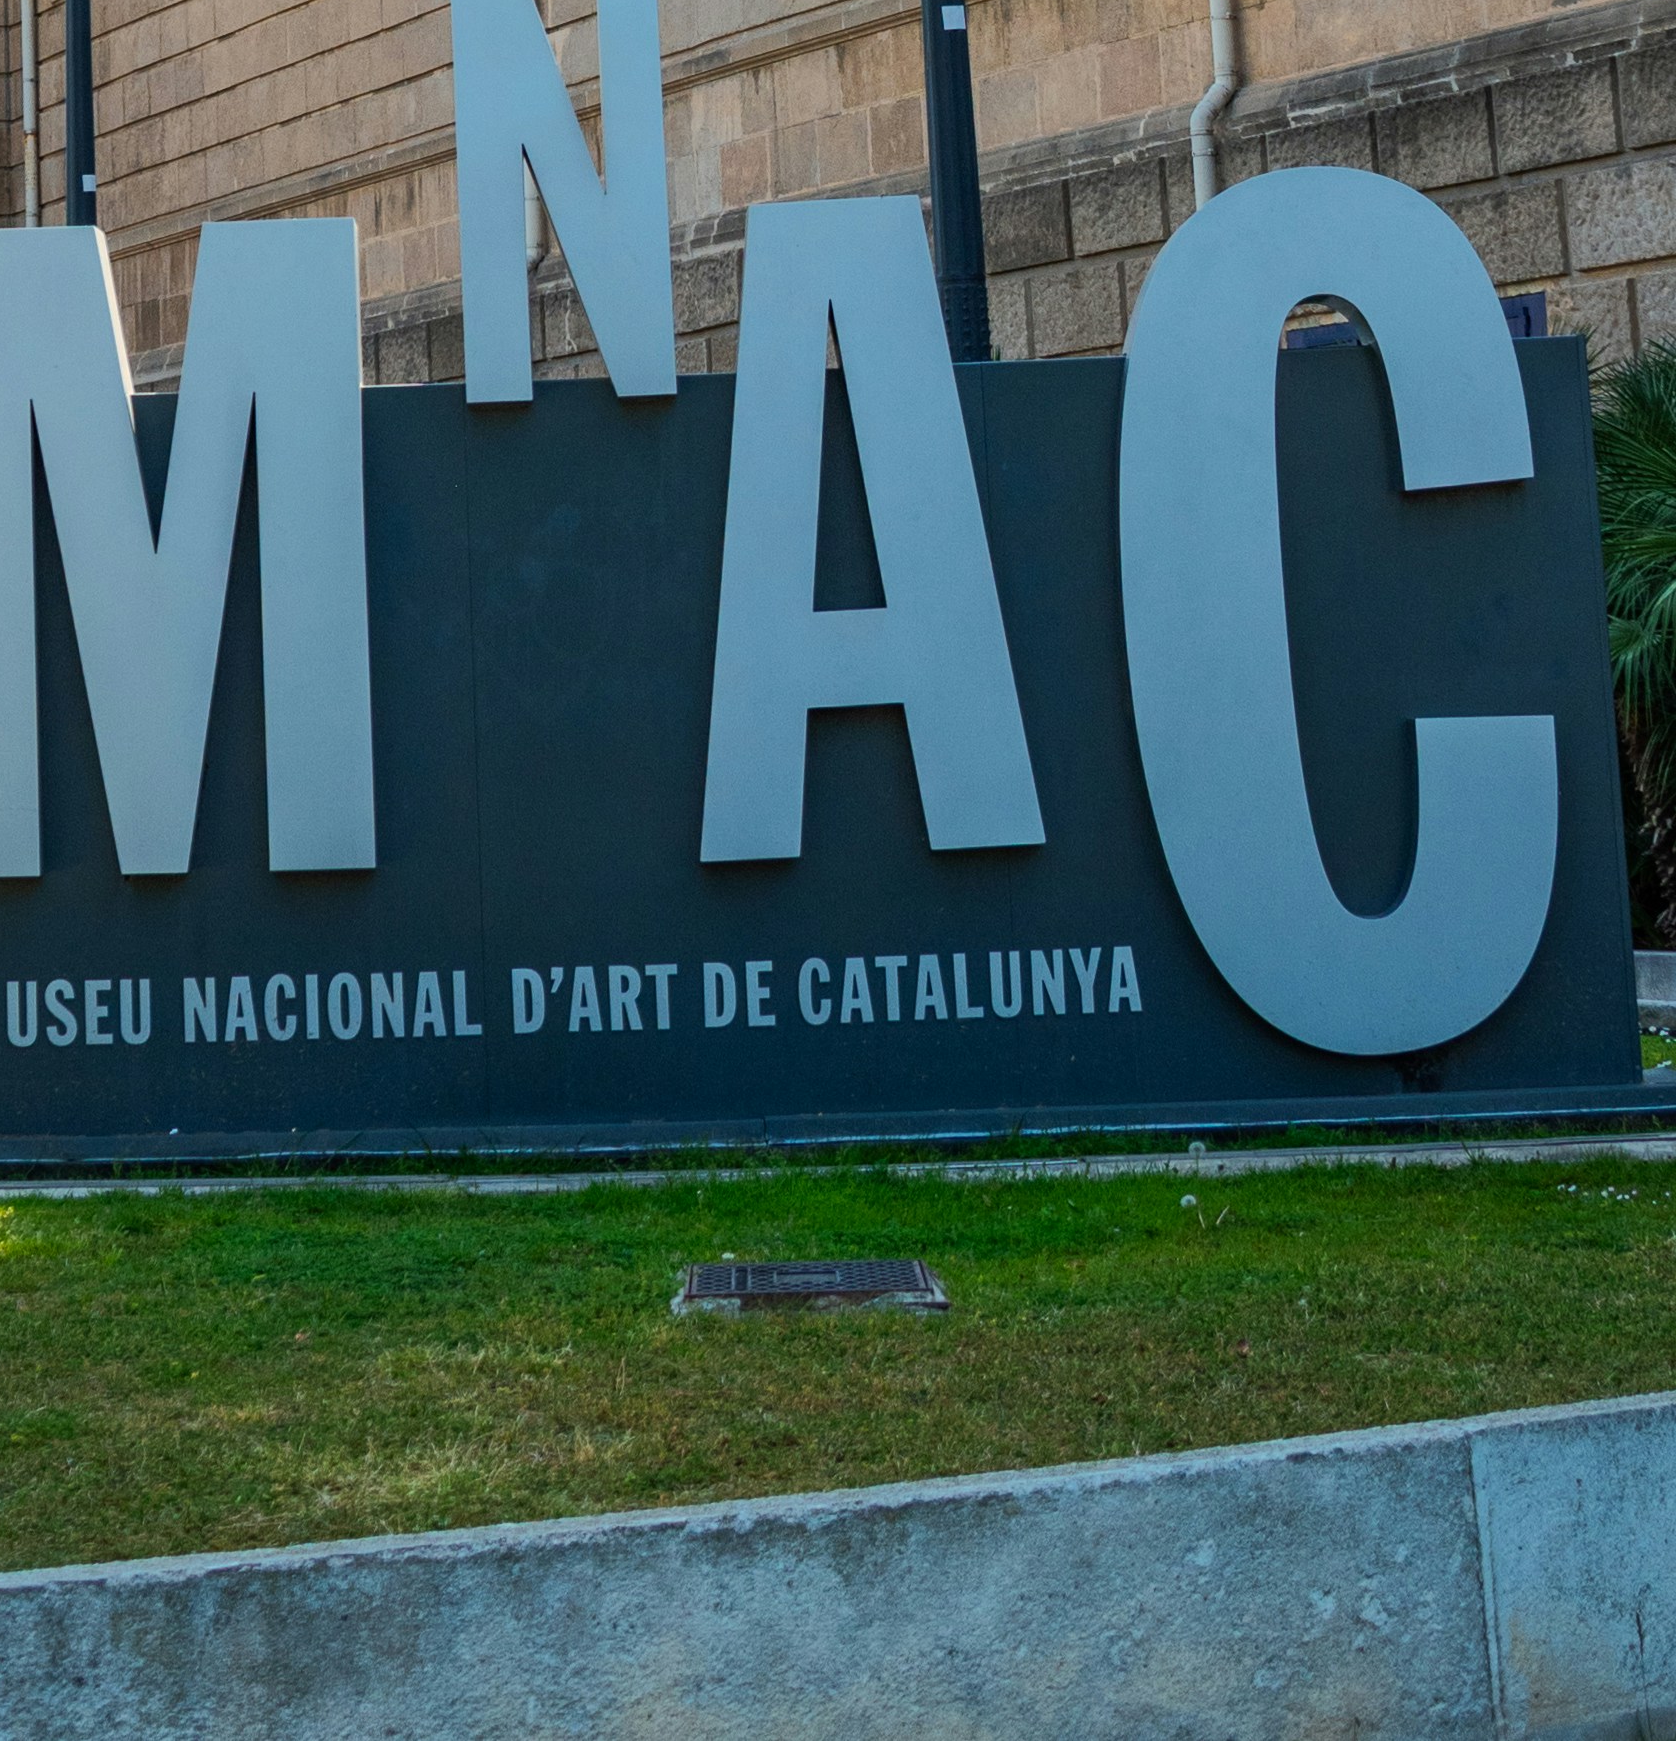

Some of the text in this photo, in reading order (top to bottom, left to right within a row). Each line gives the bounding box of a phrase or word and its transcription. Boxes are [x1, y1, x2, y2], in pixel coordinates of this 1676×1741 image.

[182, 970, 482, 1043] NACIONAL
[511, 964, 677, 1034] D'ART
[702, 960, 776, 1028] DE
[797, 946, 1143, 1025] CATALUNYA
